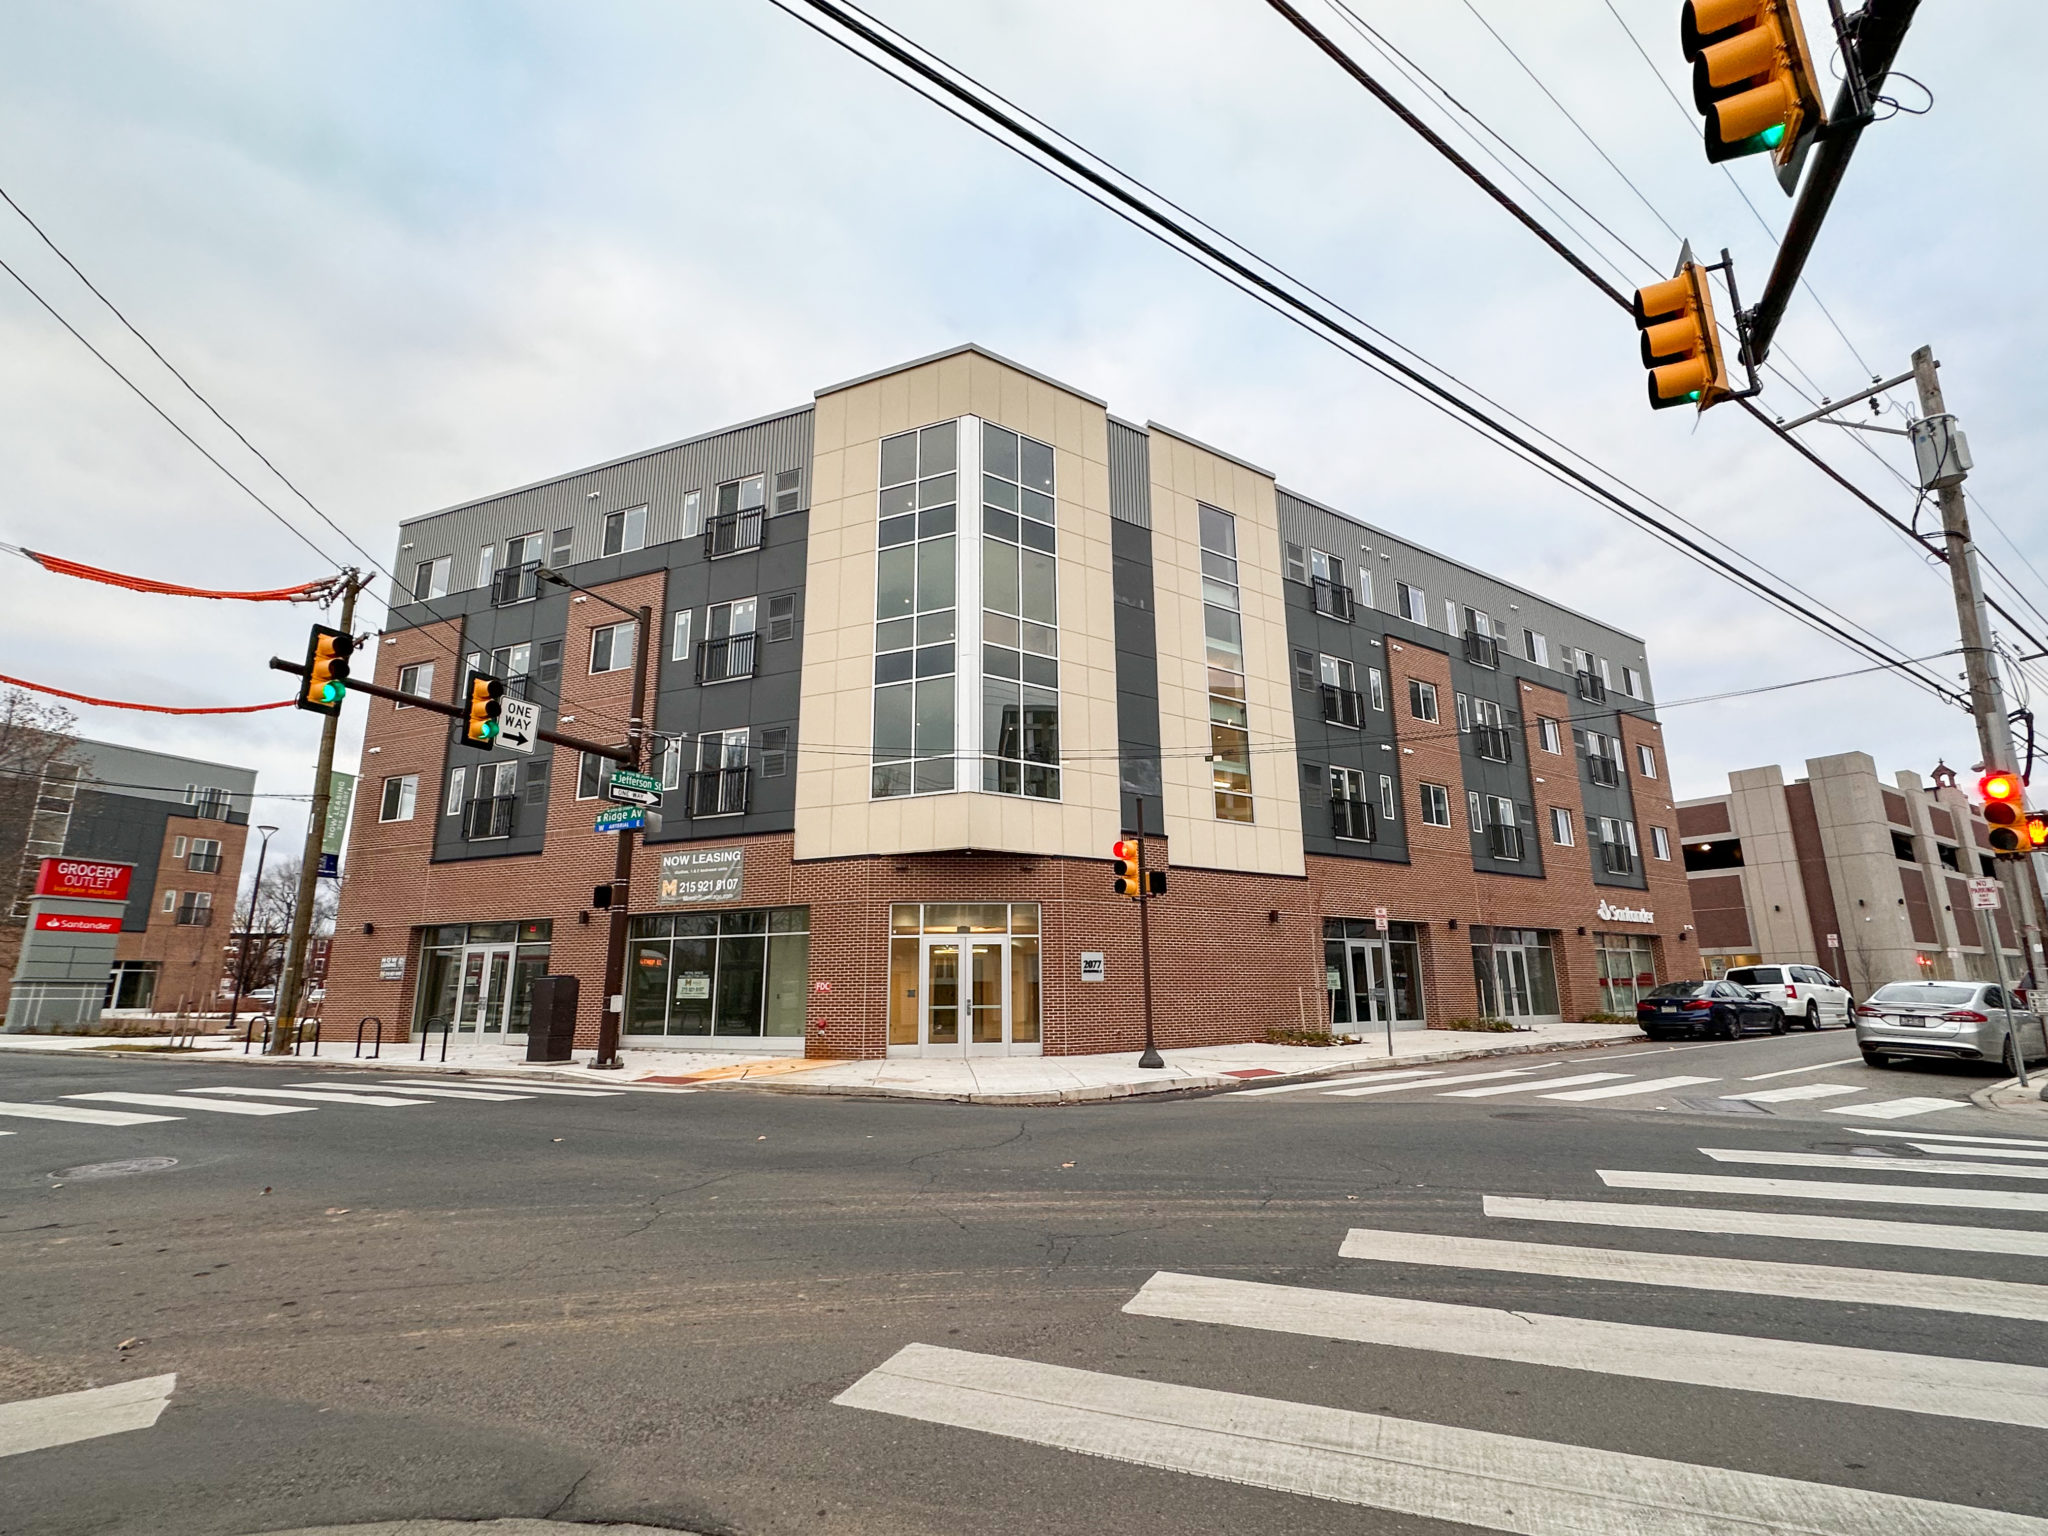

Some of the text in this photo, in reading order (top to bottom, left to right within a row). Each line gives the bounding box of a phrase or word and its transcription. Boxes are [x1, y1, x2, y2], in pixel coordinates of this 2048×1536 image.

[508, 702, 532, 719] ONE
[505, 714, 532, 731] WAY
[618, 774, 652, 788] Jefferson
[654, 782, 662, 790] St
[327, 781, 345, 839] NOW LEASING
[602, 811, 628, 822] Ridge
[663, 850, 741, 867] NOW LEASING
[57, 862, 122, 879] GROCERY
[64, 875, 114, 888] OUTLET
[661, 879, 678, 897] M
[679, 878, 739, 893] 215 921 8107
[1609, 904, 1655, 924] Santander
[61, 919, 112, 930] Santander
[1083, 960, 1102, 969] 2077
[816, 982, 830, 990] FDC
